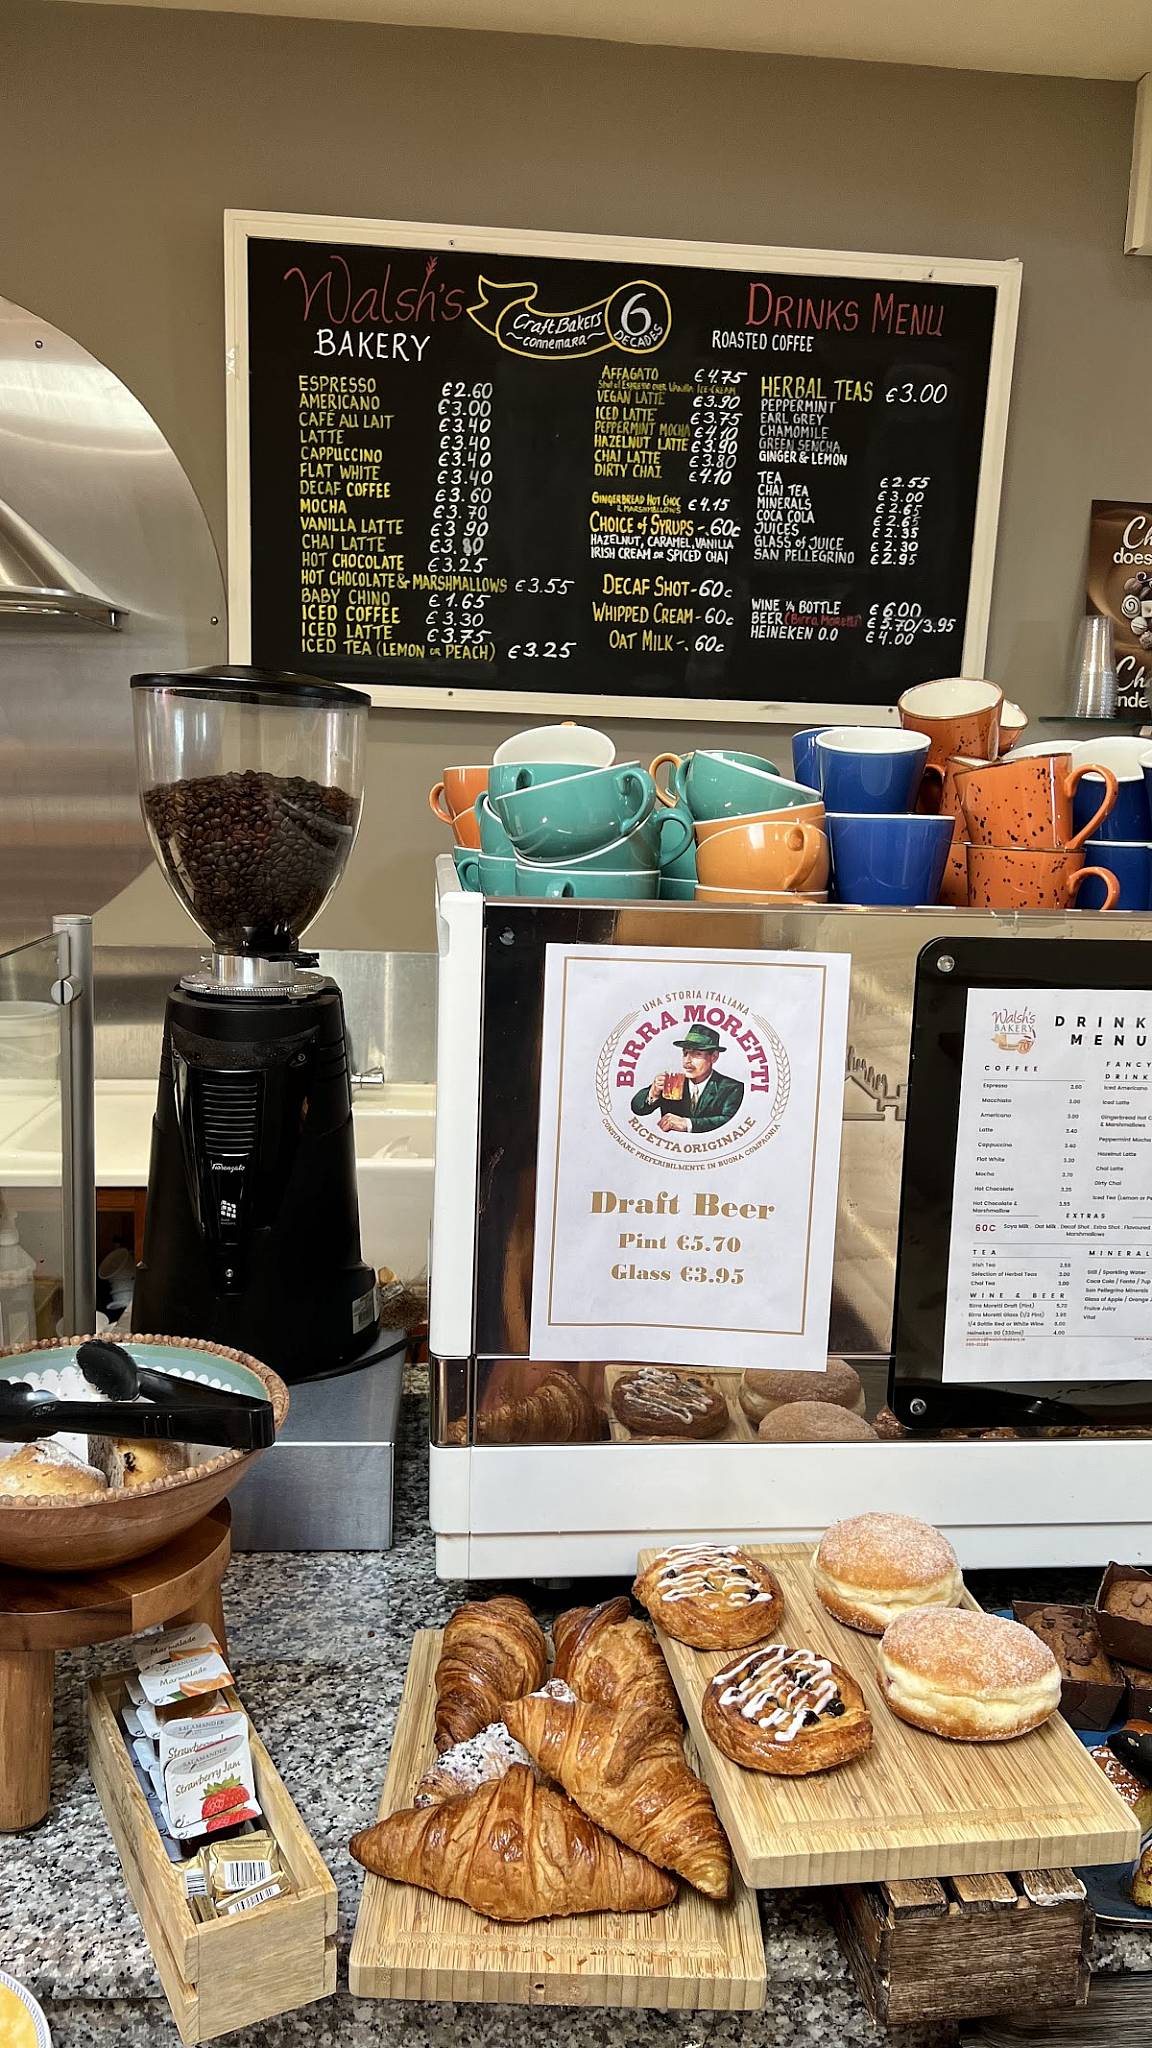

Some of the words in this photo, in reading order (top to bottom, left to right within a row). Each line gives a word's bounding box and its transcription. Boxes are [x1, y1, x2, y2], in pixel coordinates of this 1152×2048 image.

[284, 255, 465, 324] Walsh's
[620, 292, 652, 337] 6
[745, 283, 860, 332] DRINKS
[871, 292, 945, 337] MENU
[513, 313, 556, 335] Craft
[314, 328, 431, 362] BAKERY
[613, 323, 664, 348] DECADES
[712, 330, 767, 350] ROASTED
[772, 334, 814, 352] COFFEE
[601, 364, 660, 381] AFFAGATO
[298, 375, 377, 393] ESPRESSO
[761, 376, 827, 400] HERBAL
[834, 379, 874, 402] TEAS
[299, 393, 381, 411] AMERICANO
[596, 389, 632, 406] VEGAN
[635, 391, 666, 406] LATTE
[761, 399, 837, 414] PEPPERMINT
[298, 409, 336, 427] CAFÉ
[339, 414, 359, 428] AU
[363, 414, 396, 429] LAIT
[595, 405, 619, 421] ICED
[622, 407, 658, 423] LATTE
[760, 412, 789, 425] EARL
[793, 412, 825, 426] GREY
[300, 429, 345, 444] LATTE
[659, 423, 691, 438] MOCHA
[759, 424, 829, 440] CHAMOMILE
[594, 434, 651, 449] HAZELNUT
[657, 437, 691, 452] LATTE
[758, 440, 795, 452] GREEN
[797, 439, 841, 453] SENCHA
[300, 446, 383, 464] CAPPUCCINO
[594, 449, 622, 463] CHAI
[626, 450, 662, 465] LATTE
[759, 450, 798, 464] GINGER
[811, 451, 848, 467] LEMON
[299, 462, 334, 479] FLAT
[340, 464, 381, 481] WHITE
[594, 462, 628, 478] DIRTY
[632, 464, 663, 479] CHAI
[756, 471, 783, 485] TEA
[300, 480, 342, 496] DECAF
[346, 482, 392, 499] COFFEE
[757, 484, 784, 497] CHAI
[787, 484, 809, 498] TEA
[300, 498, 348, 514] MOCHA
[646, 494, 661, 507] HOT
[756, 496, 812, 510] MINERALS
[300, 516, 357, 533] VANILLA
[361, 518, 405, 535] LATTE
[589, 510, 634, 534] CHOICE
[636, 516, 648, 535] of
[650, 513, 695, 537] SYRUPS
[756, 509, 783, 523] COCA
[787, 510, 815, 524] COLA
[753, 522, 800, 537] JUICES
[301, 533, 334, 550] CHAI
[341, 535, 387, 553] LATTE
[590, 533, 645, 549] HAZELNUT,
[695, 537, 734, 550] VANILLA
[754, 535, 792, 549] GLASS
[795, 535, 807, 549] of
[808, 536, 845, 551] JUICE
[302, 551, 329, 567] HOT
[332, 552, 405, 571] CHOCOLATE
[590, 546, 616, 559] IRISH
[617, 548, 651, 560] CREAM
[665, 549, 701, 563] SPICED
[705, 550, 729, 565] CHAI
[753, 549, 780, 561] SAN
[784, 550, 855, 565] PELLEGRINO
[301, 569, 326, 586] HOT
[412, 574, 508, 593] MARSHMALLOWS
[602, 573, 650, 596] DECAF
[653, 575, 690, 597] SHOT
[301, 587, 341, 604] BABY
[348, 589, 391, 607] CHINO
[751, 598, 780, 612] WINE
[799, 600, 842, 615] BOTTLE
[301, 604, 338, 621] ICED
[345, 605, 401, 624] COFFEE
[592, 601, 649, 624] WHIPPED
[653, 602, 694, 625] CREAM
[750, 611, 784, 625] BEER
[301, 621, 337, 638] ICED
[346, 623, 393, 640] LATTE
[750, 625, 814, 641] HEINEKEN
[817, 627, 839, 642] 0.0
[301, 638, 337, 654] ICED
[342, 640, 372, 656] TEA
[376, 640, 426, 658] (LEMON
[445, 641, 496, 662] PEACH)
[609, 629, 638, 650] OAT
[641, 629, 674, 652] MILK
[642, 997, 663, 1013] UNA
[665, 989, 702, 1003] STORIA
[705, 990, 751, 1016] ITALIANA
[991, 1005, 1037, 1025] Walsh's
[994, 1024, 1034, 1033] BAKERY
[616, 1010, 679, 1088] BIRRA
[682, 1004, 770, 1093] MORETTI
[1070, 1033, 1147, 1047] MENU
[984, 1064, 1038, 1072] COFFEE
[982, 1082, 1008, 1090] Espresso
[601, 1117, 635, 1153] CONSUMARE
[635, 1149, 706, 1171] PREFERIBILMENTE
[707, 1161, 717, 1170] IN
[717, 1153, 745, 1168] BUONA
[744, 1123, 781, 1157] COMPAGNIA
[628, 1116, 682, 1153] RICETTA
[684, 1116, 756, 1154] ORIGINALE
[590, 1191, 681, 1216] Draft
[693, 1192, 776, 1220] Beer
[975, 1223, 997, 1232] 60C
[619, 1232, 668, 1250] Pint
[676, 1234, 742, 1253] €5.70
[611, 1263, 672, 1281] Glass
[680, 1265, 745, 1285] €3.95
[150, 1635, 196, 1656] Marmalade
[159, 1666, 207, 1687] Marmalade
[175, 1768, 221, 1797] Strawberry
[222, 1760, 241, 1773] Jam
